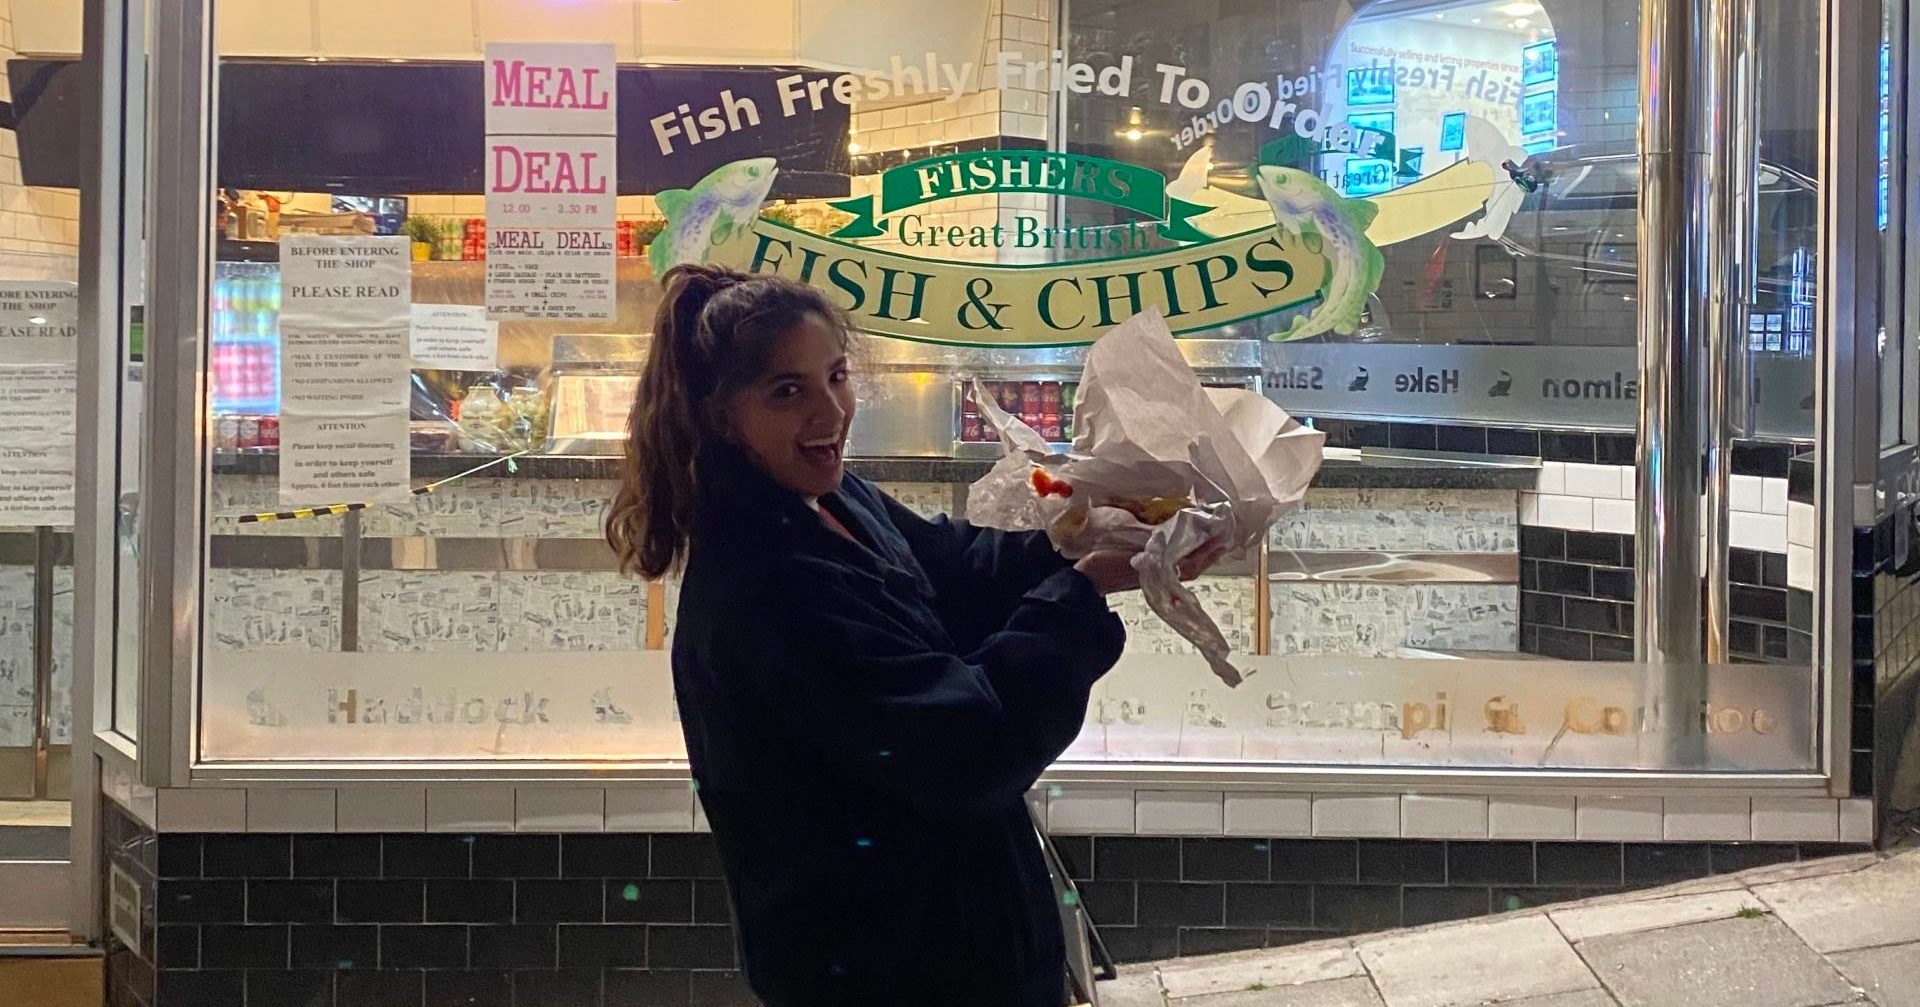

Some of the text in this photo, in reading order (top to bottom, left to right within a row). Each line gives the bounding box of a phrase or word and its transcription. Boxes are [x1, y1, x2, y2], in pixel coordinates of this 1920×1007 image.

[492, 60, 609, 110] MEAL
[650, 87, 760, 155] Fish
[775, 52, 972, 117] Freshly
[1000, 48, 1132, 96] Fried
[1156, 63, 1210, 108] To
[1233, 82, 1385, 158] Order
[492, 145, 607, 194] DEAL
[913, 159, 1134, 199] FISHERS
[503, 204, 531, 213] 12.00
[558, 204, 581, 214] 2.30
[585, 205, 598, 214] PM
[898, 214, 1149, 251] Great British
[496, 231, 605, 250] MEAL DEAL
[291, 247, 399, 256] BEFORE ENTERING
[315, 260, 376, 269] THE SHOP
[751, 231, 1294, 331] FISH & CHIPS
[0, 291, 78, 299] ORE ENTERING
[292, 286, 400, 298] PLEASE READ
[3, 302, 57, 310] THE SHOP
[0, 327, 76, 337] EASE READ
[316, 443, 333, 451] keep
[357, 442, 395, 450] distancing
[304, 459, 327, 467] order
[340, 459, 359, 468] keep
[360, 458, 394, 467] yourself
[327, 687, 551, 724] Haddock
[1264, 691, 1447, 740] Scampi
